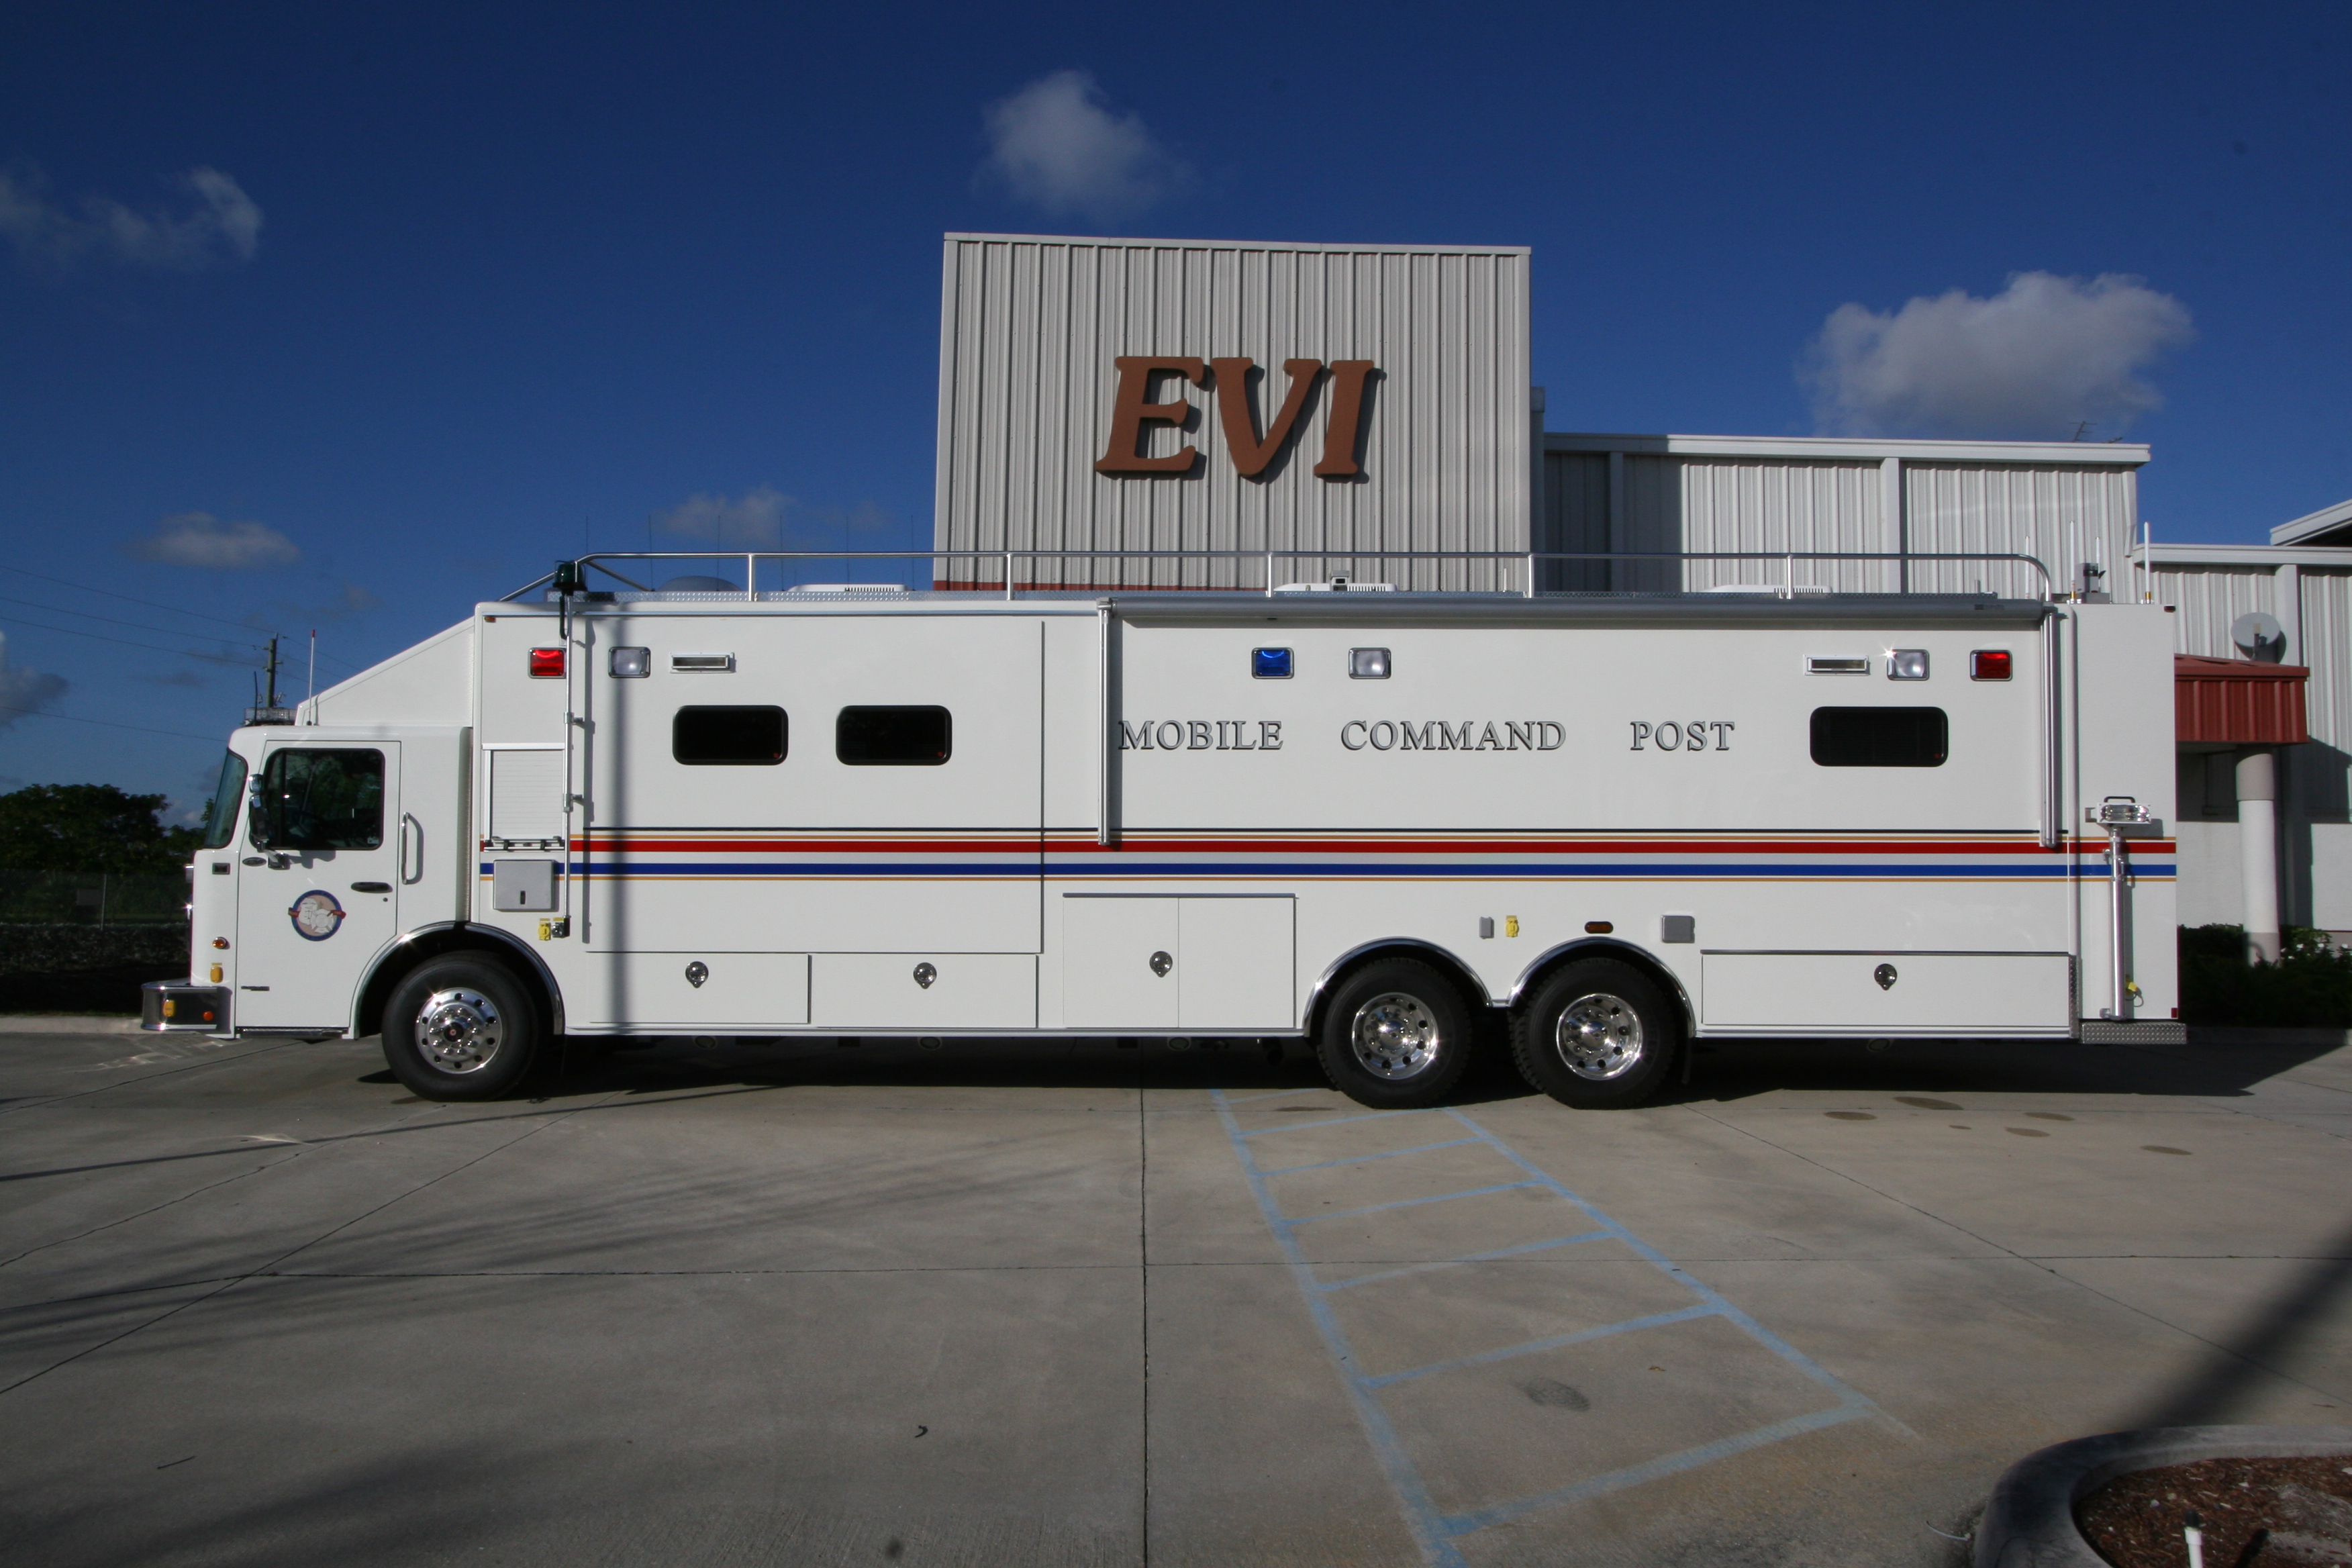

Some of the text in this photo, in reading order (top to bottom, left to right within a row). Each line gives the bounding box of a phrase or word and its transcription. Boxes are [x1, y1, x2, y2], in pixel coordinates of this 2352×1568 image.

[1095, 356, 1375, 475] EVI
[1118, 720, 1735, 751] MOBILE COMMAND POST
